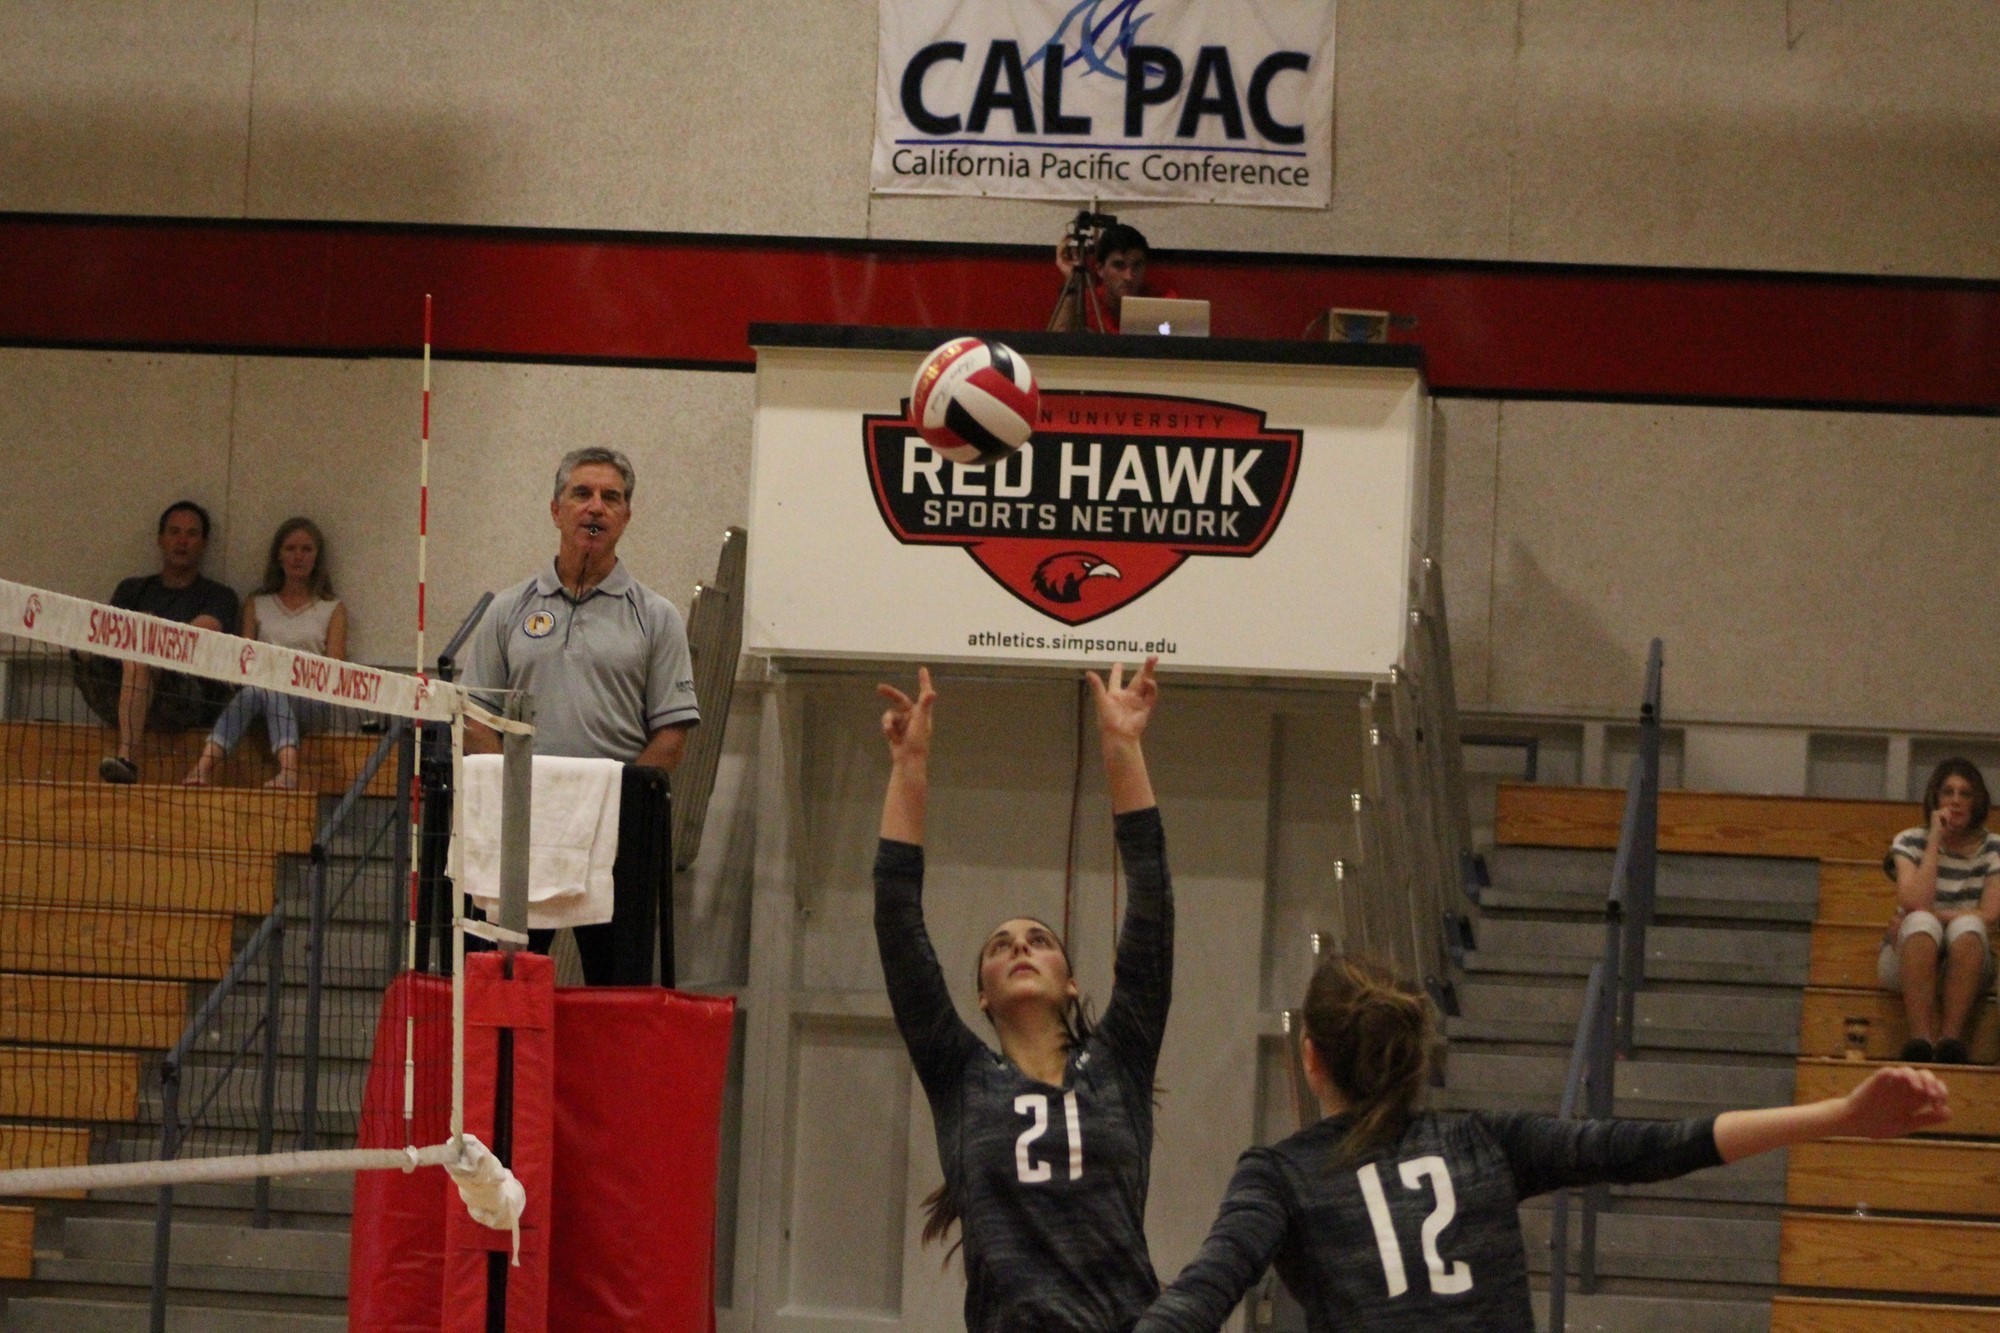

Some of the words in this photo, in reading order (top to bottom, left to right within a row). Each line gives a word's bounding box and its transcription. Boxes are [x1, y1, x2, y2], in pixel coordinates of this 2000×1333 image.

[900, 39, 1093, 136] CAL
[1123, 45, 1311, 145] PAC
[892, 147, 1031, 178] California
[1040, 153, 1130, 181] Pacific
[1142, 154, 1310, 187] Conference
[1069, 410, 1225, 430] UNIVERSITY
[902, 437, 1033, 497] RED
[1059, 442, 1264, 507] HAWK
[923, 500, 1057, 531] SPORTS
[1072, 505, 1240, 537] NETWORK
[968, 631, 1177, 655] athletics.simpsonu.edu
[1014, 1090, 1083, 1183] 21
[1357, 1155, 1474, 1298] 12
